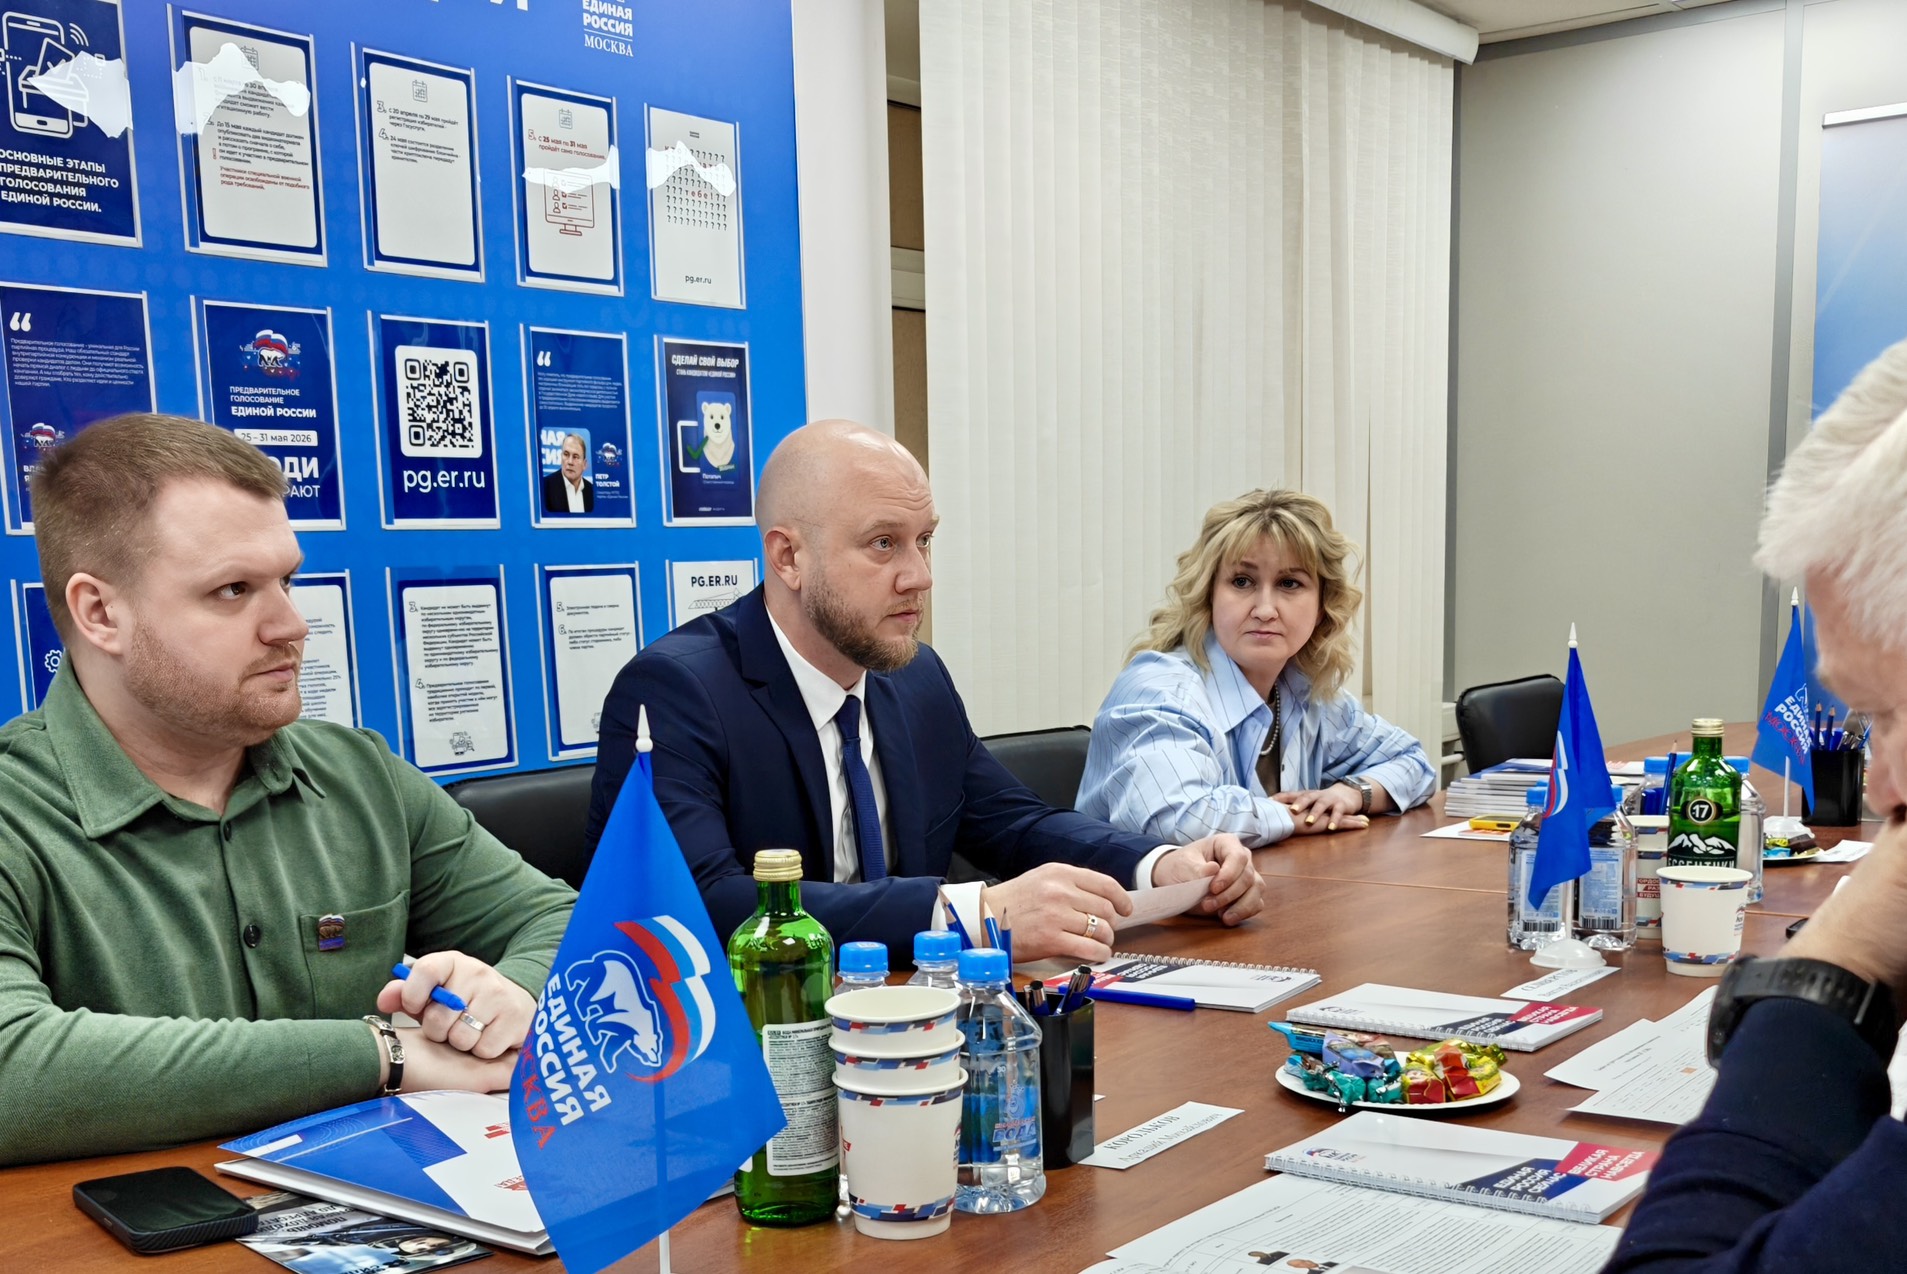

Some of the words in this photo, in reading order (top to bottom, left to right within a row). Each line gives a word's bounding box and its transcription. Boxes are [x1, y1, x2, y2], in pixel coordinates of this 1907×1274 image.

[582, 0, 632, 20] ЕДИНАЯ
[583, 13, 633, 36] РОССИЯ
[584, 34, 634, 57] МОСКВА
[0, 149, 64, 166] ОСНОВНЫЕ
[66, 159, 105, 173] ЭТАПЫ
[0, 162, 119, 188] ПРЕДВАРИТЕЛЬНОГО
[0, 177, 86, 197] ГОЛОСОВАНИЯ
[1, 190, 50, 206] ЕДИНОЙ
[53, 198, 102, 212] РОССИИ.
[685, 275, 711, 284] pg.er.ru
[672, 354, 697, 366] СДЕЛАЙ
[699, 356, 716, 366] СВОЙ
[717, 358, 739, 368] ВЫБОР
[230, 386, 300, 396] ПРЕДВАРИТЕЛЬНОЕ
[230, 395, 284, 404] ГОЛОСОВАНИЕ
[231, 405, 275, 417] ЕДИНОЙ
[276, 408, 317, 418] РОССИИ
[290, 434, 312, 442] 2026
[403, 470, 485, 493] pg.er.ru
[691, 575, 738, 587] PG.ER.RU
[547, 973, 612, 1112] ЕДИНАЯ
[535, 988, 584, 1126] РОССИЯ
[520, 1029, 557, 1150] ОСКВА
[1493, 1166, 1535, 1188] ЕДИНАЯ
[1510, 1168, 1552, 1191] РОССИЯ
